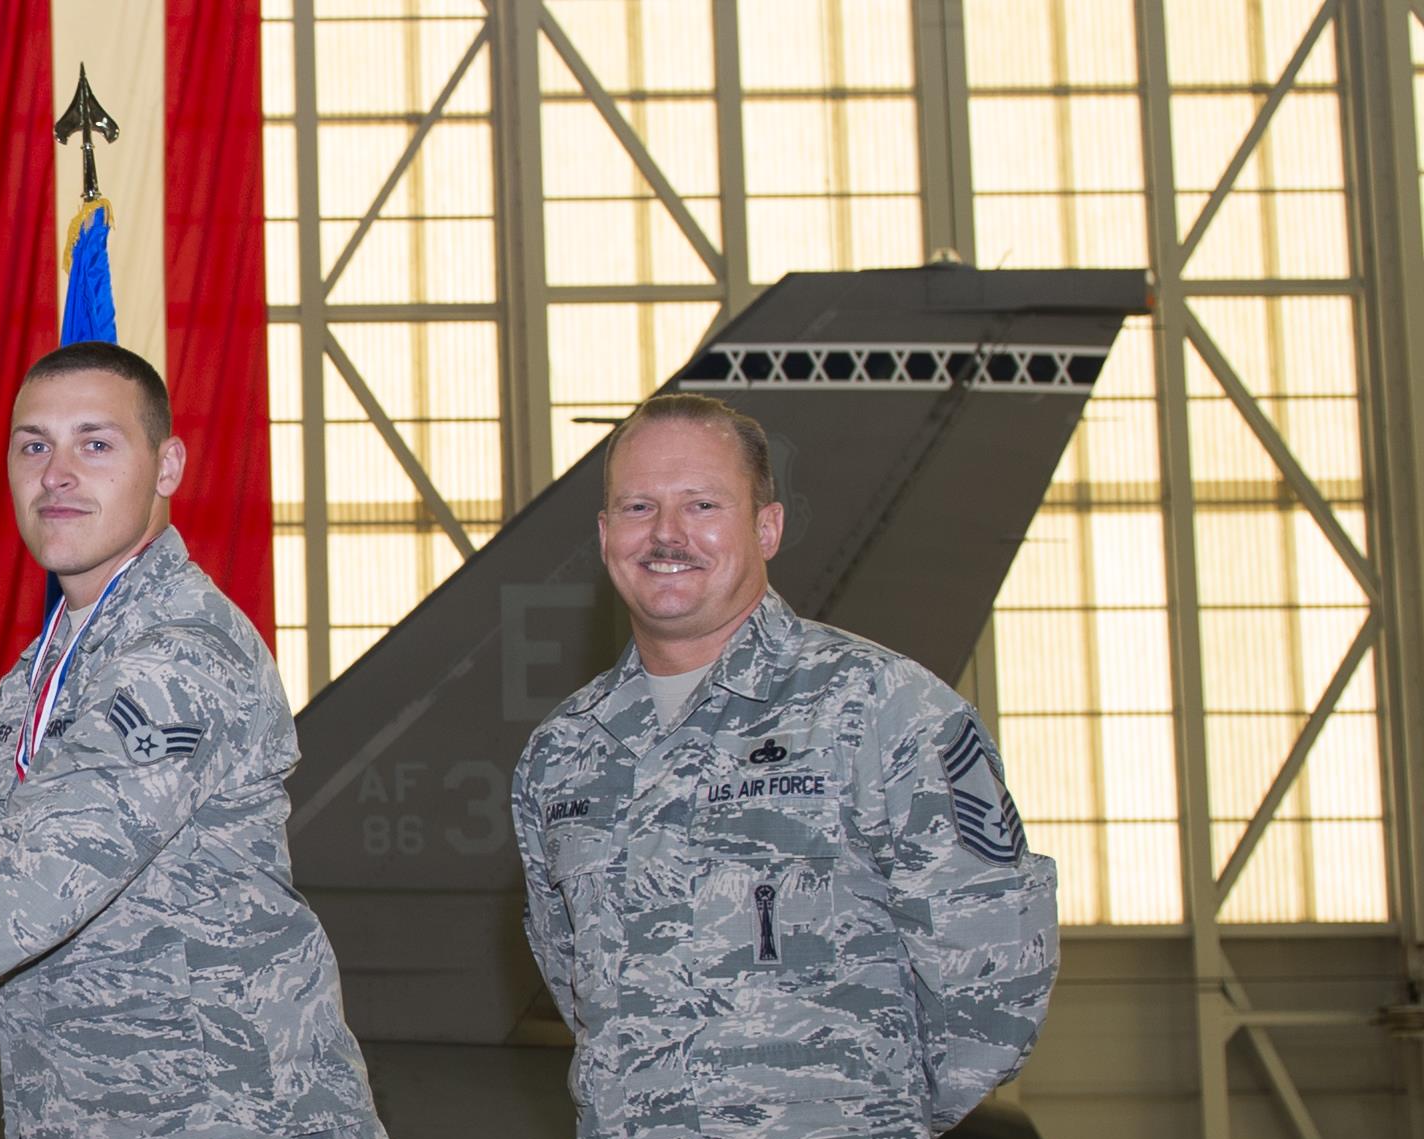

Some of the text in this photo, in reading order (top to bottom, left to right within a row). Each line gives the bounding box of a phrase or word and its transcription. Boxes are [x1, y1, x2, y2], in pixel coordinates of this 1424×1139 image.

[357, 761, 429, 804] AF
[707, 775, 825, 802] U.S. AIR FORCE
